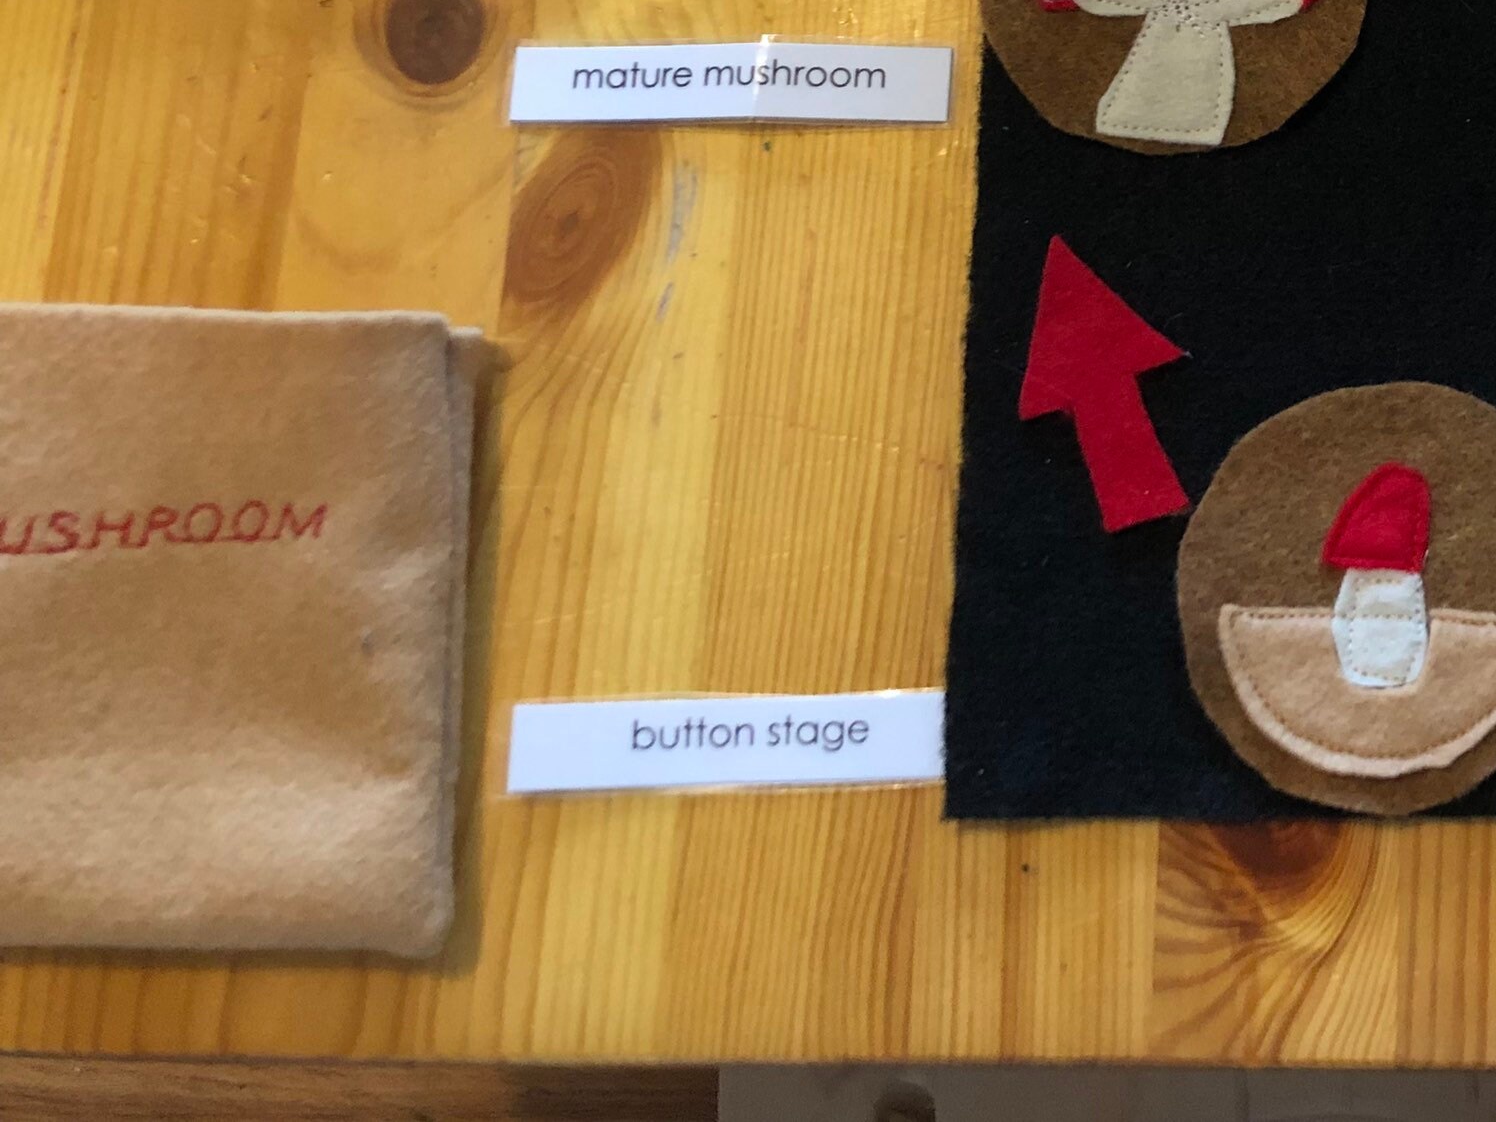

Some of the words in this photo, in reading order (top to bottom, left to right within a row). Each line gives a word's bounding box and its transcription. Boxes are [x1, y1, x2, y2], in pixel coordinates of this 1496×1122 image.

[572, 62, 692, 89] mature
[703, 59, 886, 87] mushroom
[632, 717, 755, 750] button
[767, 714, 870, 751] stage
